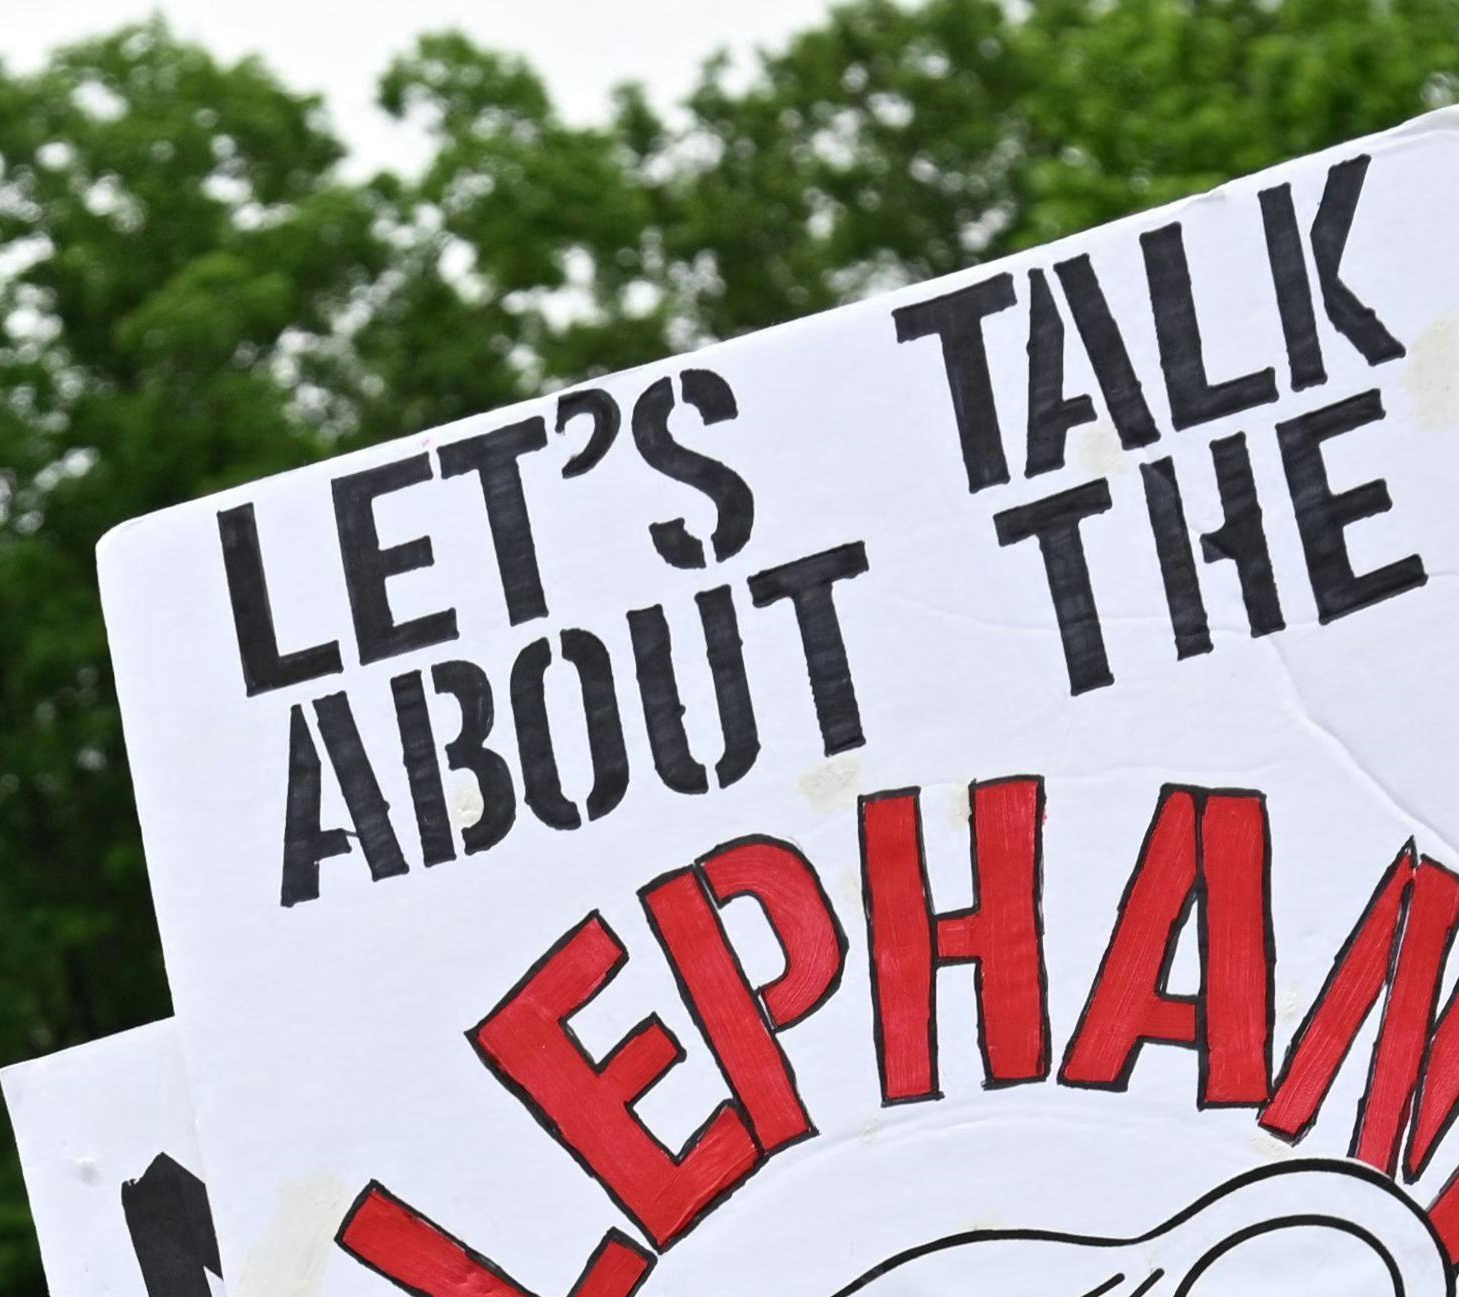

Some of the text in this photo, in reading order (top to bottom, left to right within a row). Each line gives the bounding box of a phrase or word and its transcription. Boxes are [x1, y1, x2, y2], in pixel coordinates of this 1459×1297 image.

[216, 154, 1405, 698] LET'S TALK
[280, 388, 1429, 909] ABOUT THE
